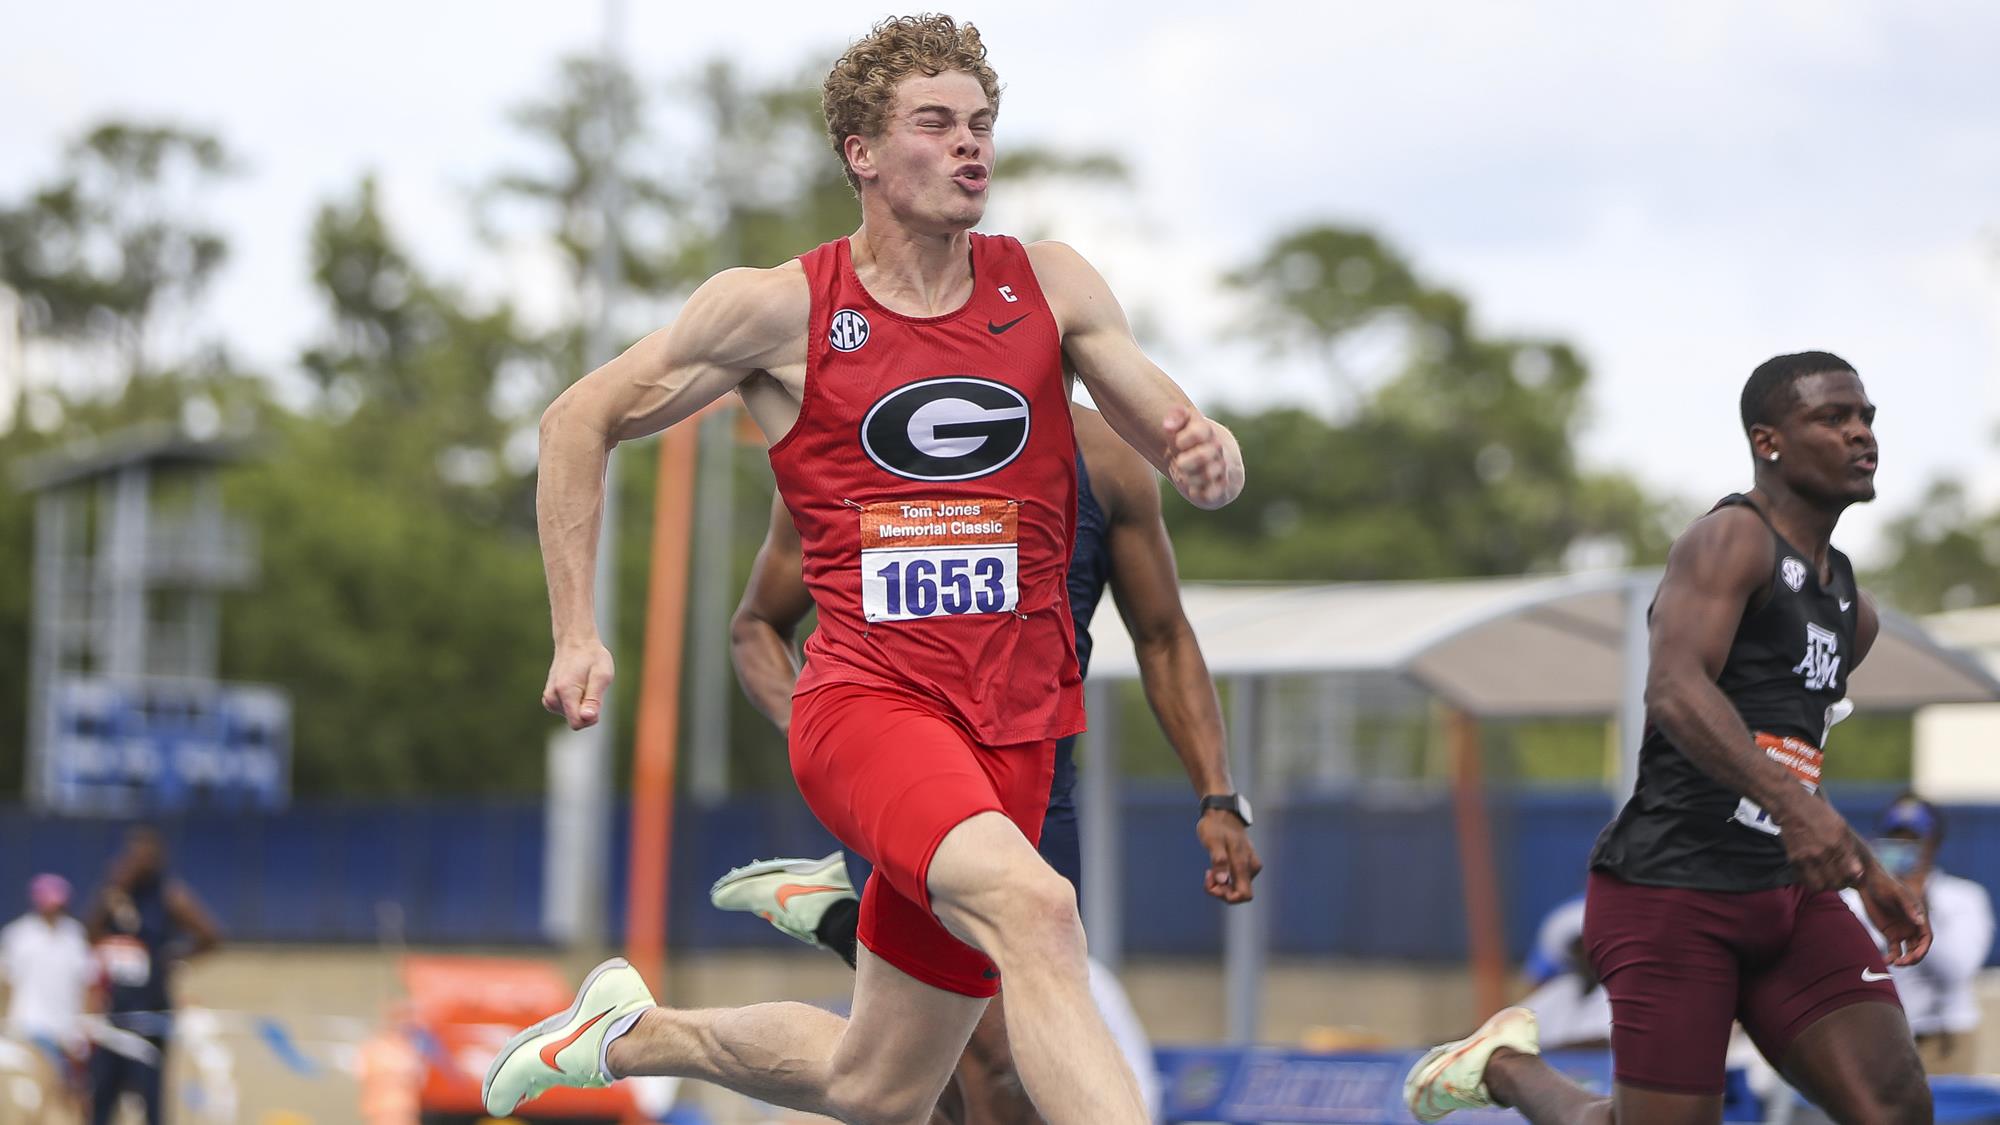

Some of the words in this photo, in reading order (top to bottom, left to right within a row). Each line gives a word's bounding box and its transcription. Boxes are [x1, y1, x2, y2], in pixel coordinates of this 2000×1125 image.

[830, 310, 869, 350] SEC
[862, 378, 1029, 480] G
[880, 522, 947, 537] Memorial
[950, 520, 1003, 535] Classic
[901, 505, 932, 518] Tom
[936, 503, 981, 517] Jones
[877, 557, 1006, 616] 1653
